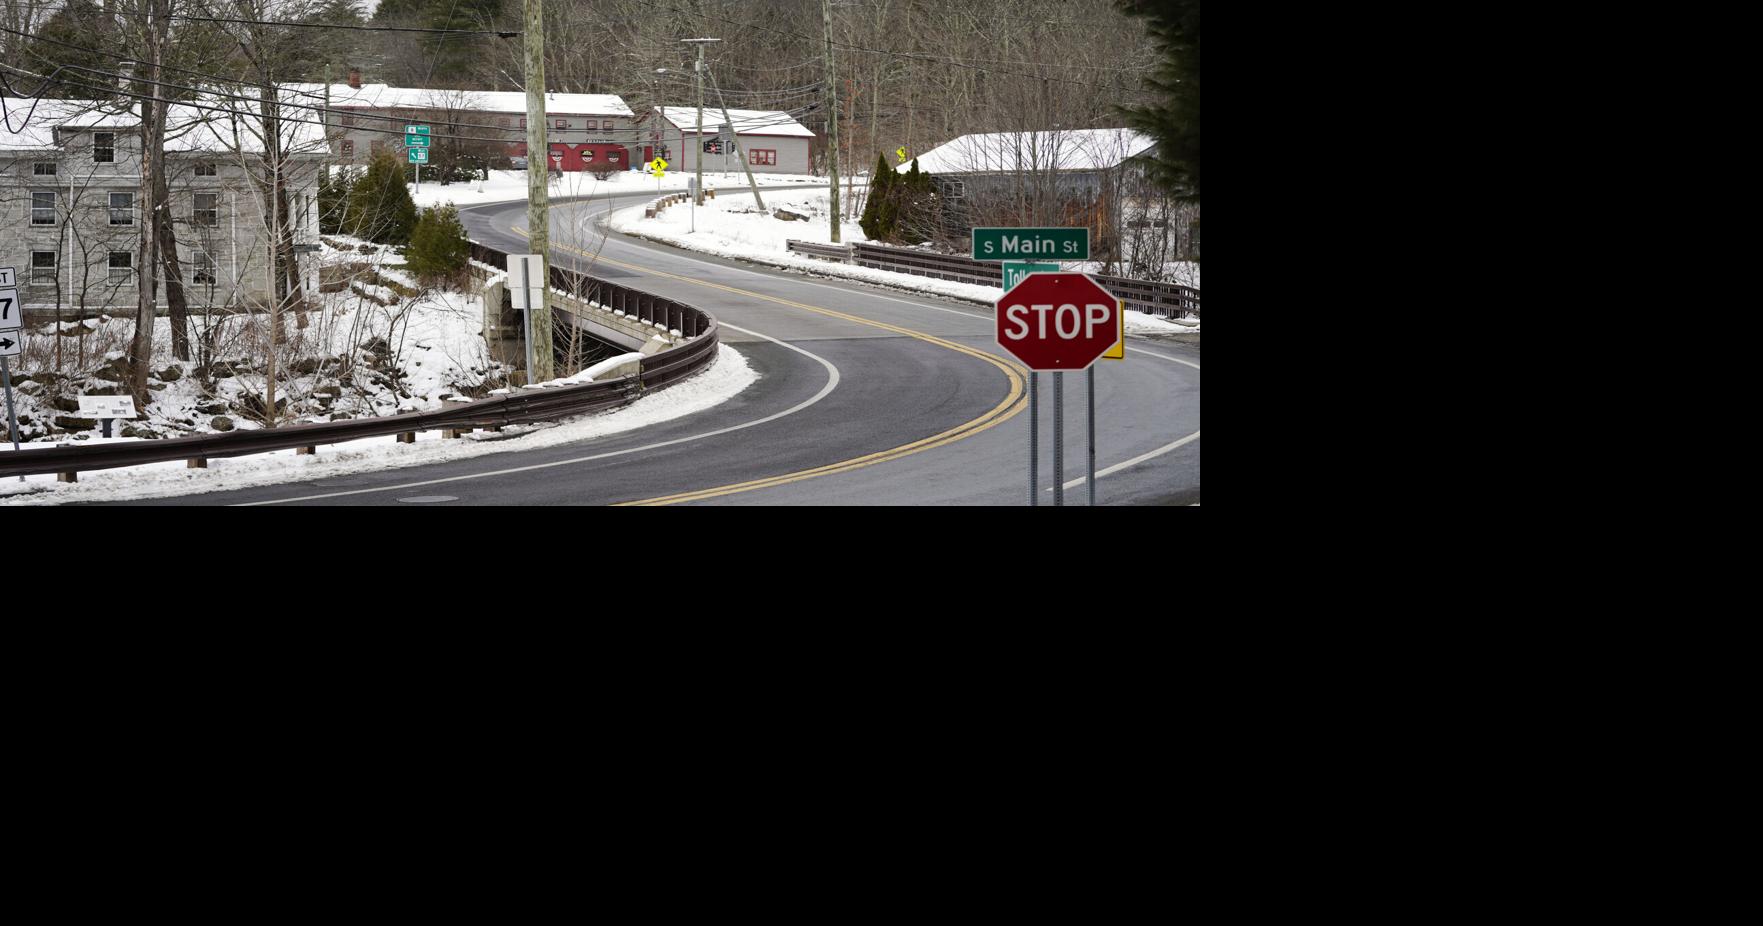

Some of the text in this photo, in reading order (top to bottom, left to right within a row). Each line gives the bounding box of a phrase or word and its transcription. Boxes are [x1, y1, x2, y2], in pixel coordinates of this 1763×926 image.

[984, 235, 1078, 253] S Main St
[1004, 304, 1110, 340] STOP
